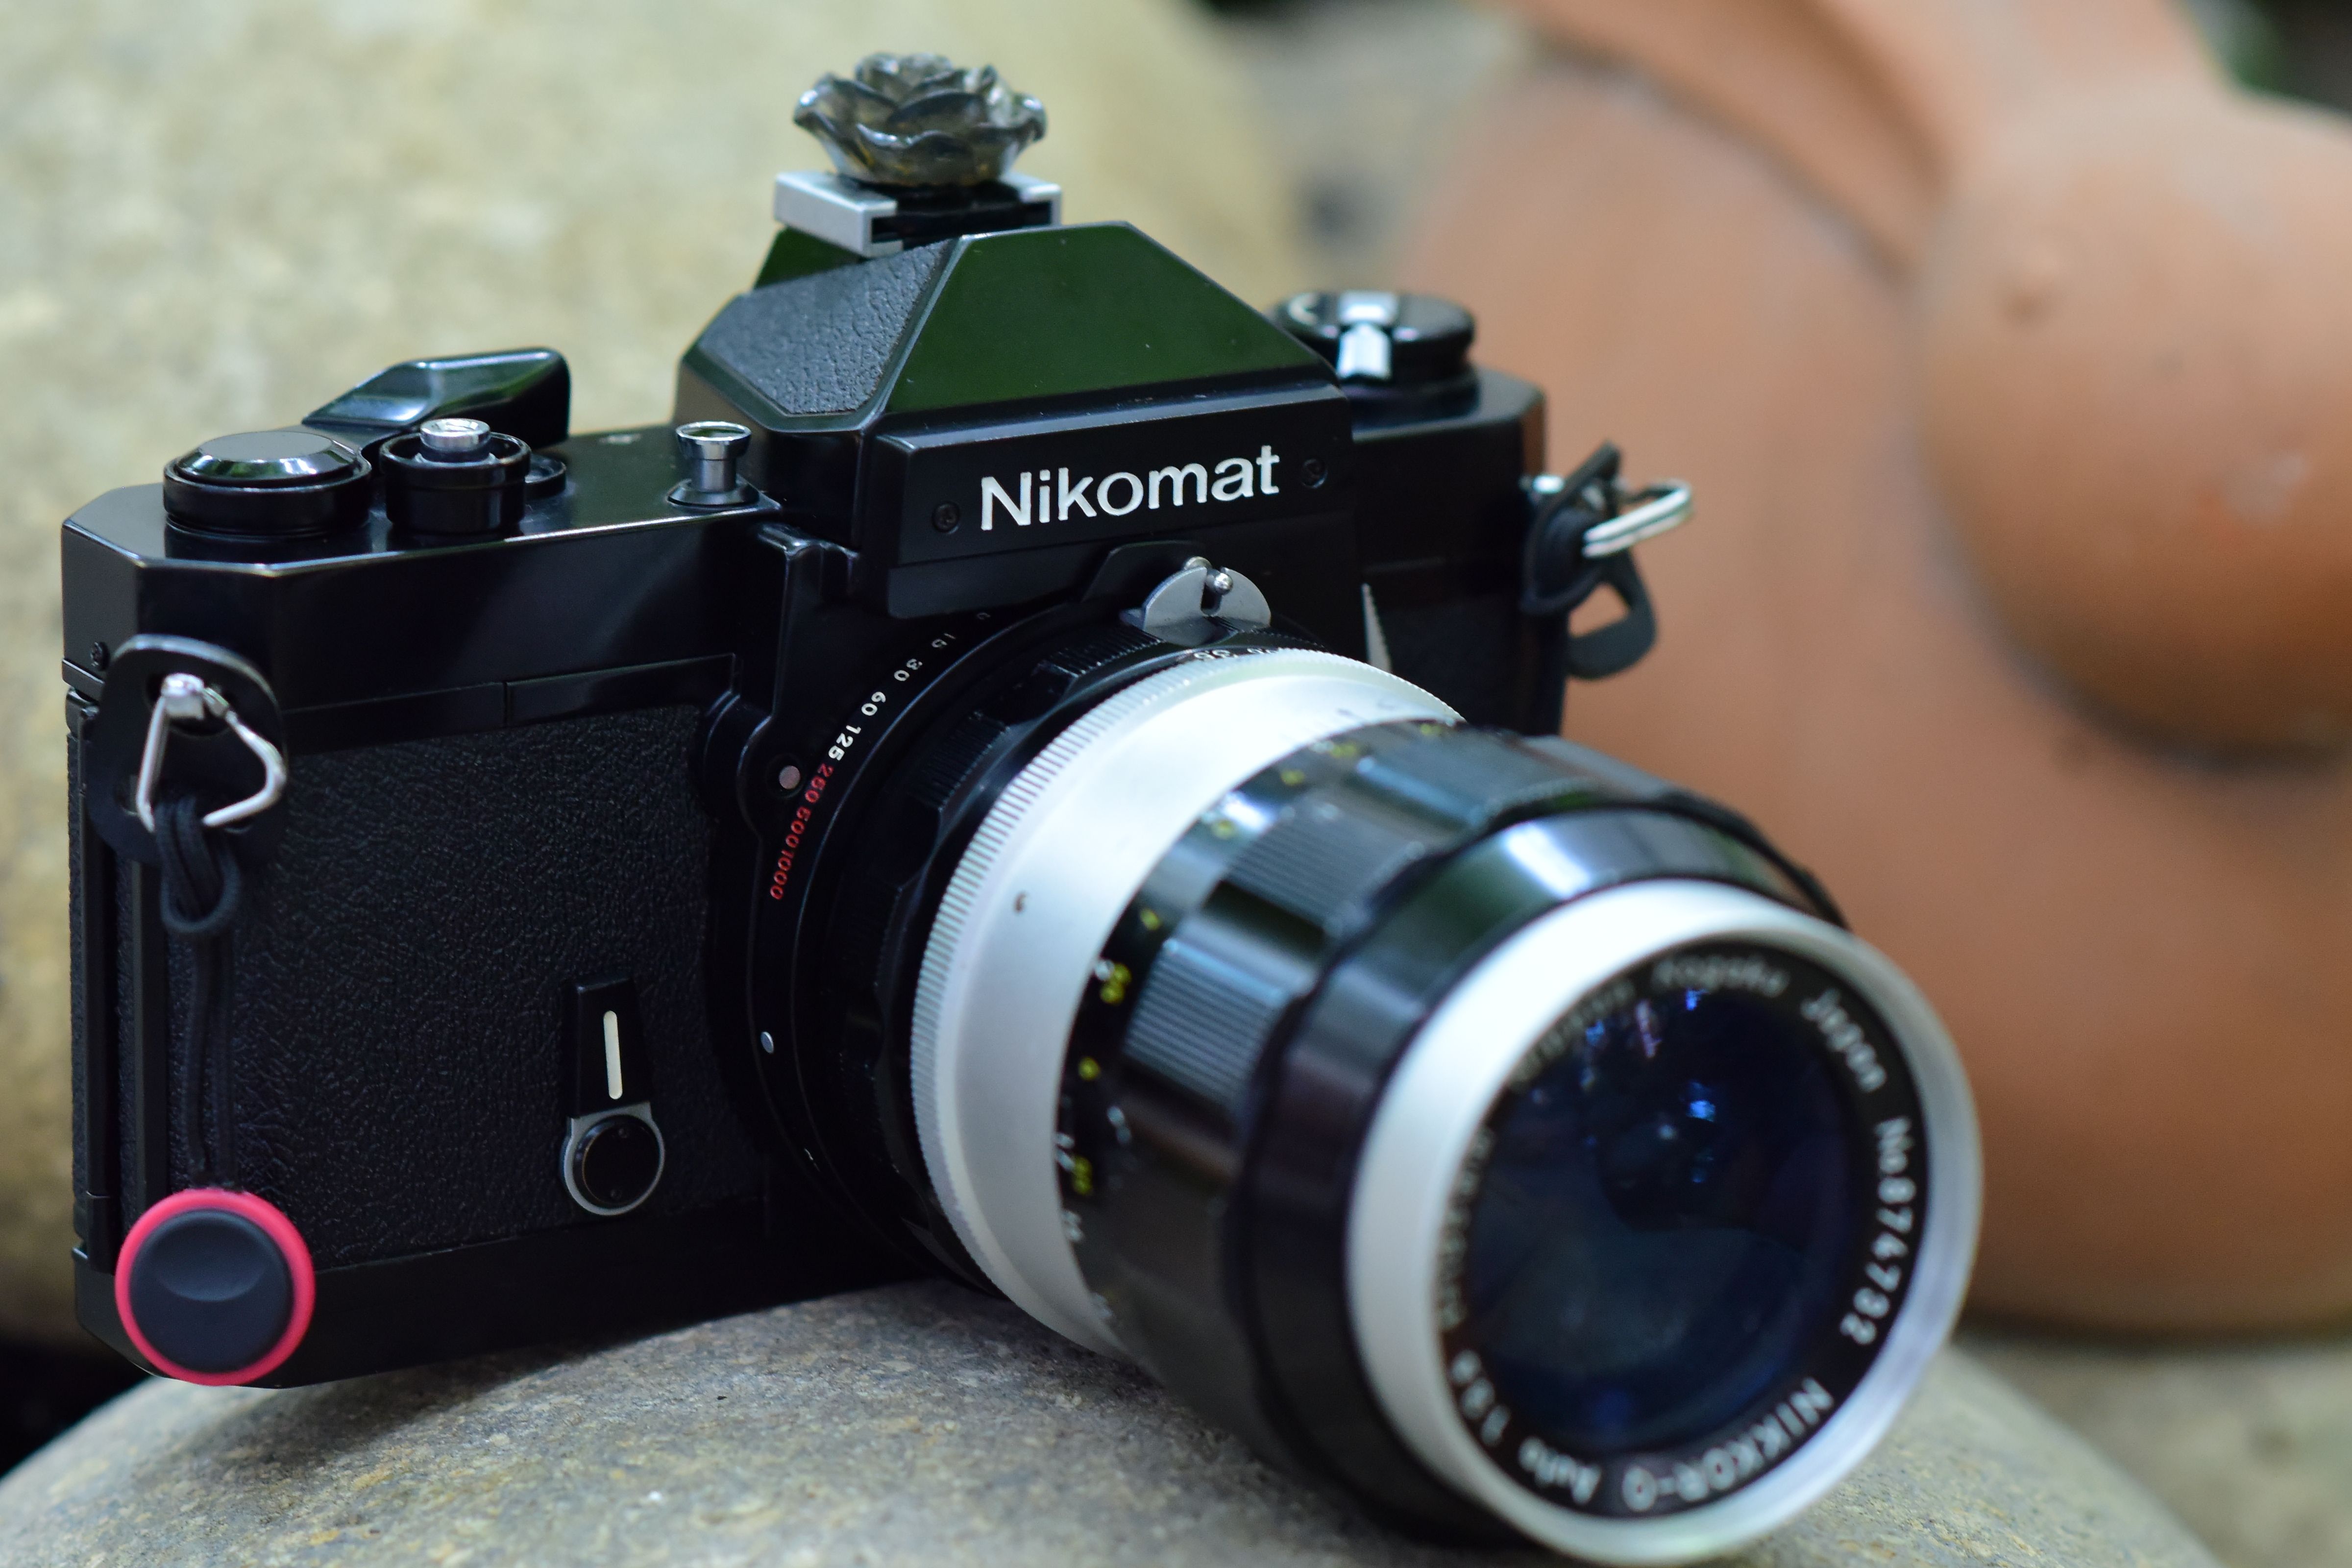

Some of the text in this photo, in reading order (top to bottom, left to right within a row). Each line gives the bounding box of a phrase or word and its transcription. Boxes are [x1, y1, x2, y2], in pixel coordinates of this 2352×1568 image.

[980, 444, 1280, 530] Nikomat
[894, 659, 923, 682] 30
[861, 691, 886, 716] 60
[828, 725, 861, 761] 125
[805, 763, 833, 803] 250
[770, 850, 794, 900] 1000
[1801, 989, 1886, 1092] Japan
[1518, 1437, 1601, 1515] Auto
